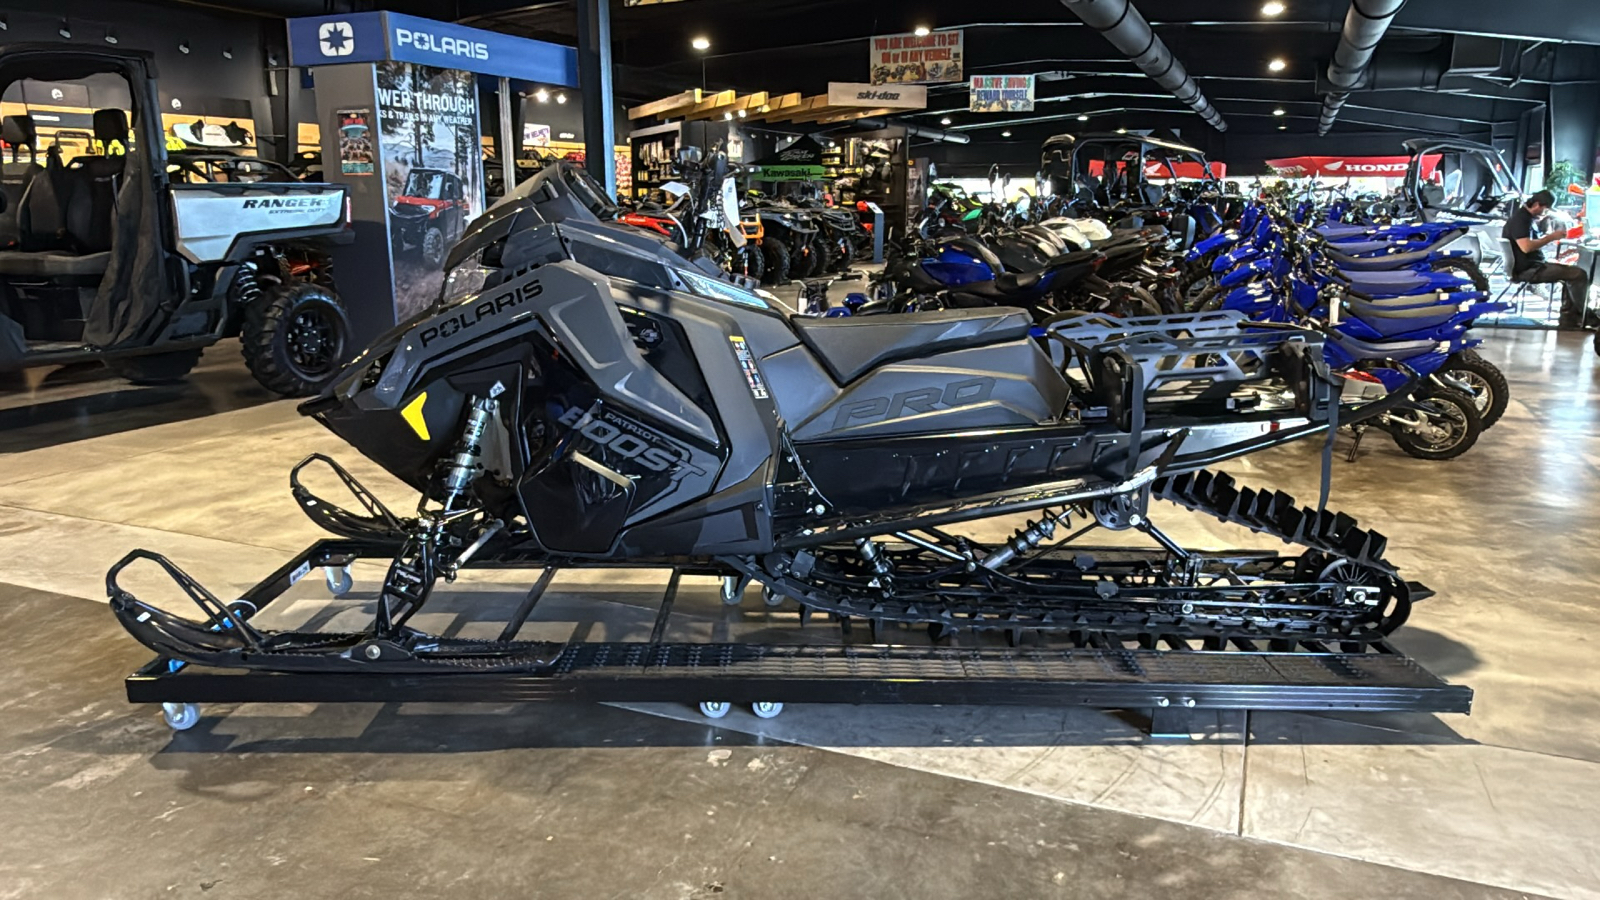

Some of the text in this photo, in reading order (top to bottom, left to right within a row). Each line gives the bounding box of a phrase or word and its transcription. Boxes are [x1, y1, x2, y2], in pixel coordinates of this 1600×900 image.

[396, 28, 489, 61] POLARIS
[937, 34, 947, 46] TO
[948, 32, 959, 45] SIT
[414, 91, 475, 114] THROUGH
[388, 111, 394, 119] &
[396, 111, 419, 122] TRAILS
[443, 116, 473, 126] WEATHER
[764, 168, 811, 177] Kawasaki
[243, 199, 322, 208] RANGER
[420, 279, 543, 348] POLARIS
[832, 376, 997, 431] PRO
[604, 412, 661, 442] PATRIOT
[558, 405, 707, 482] BOOST
